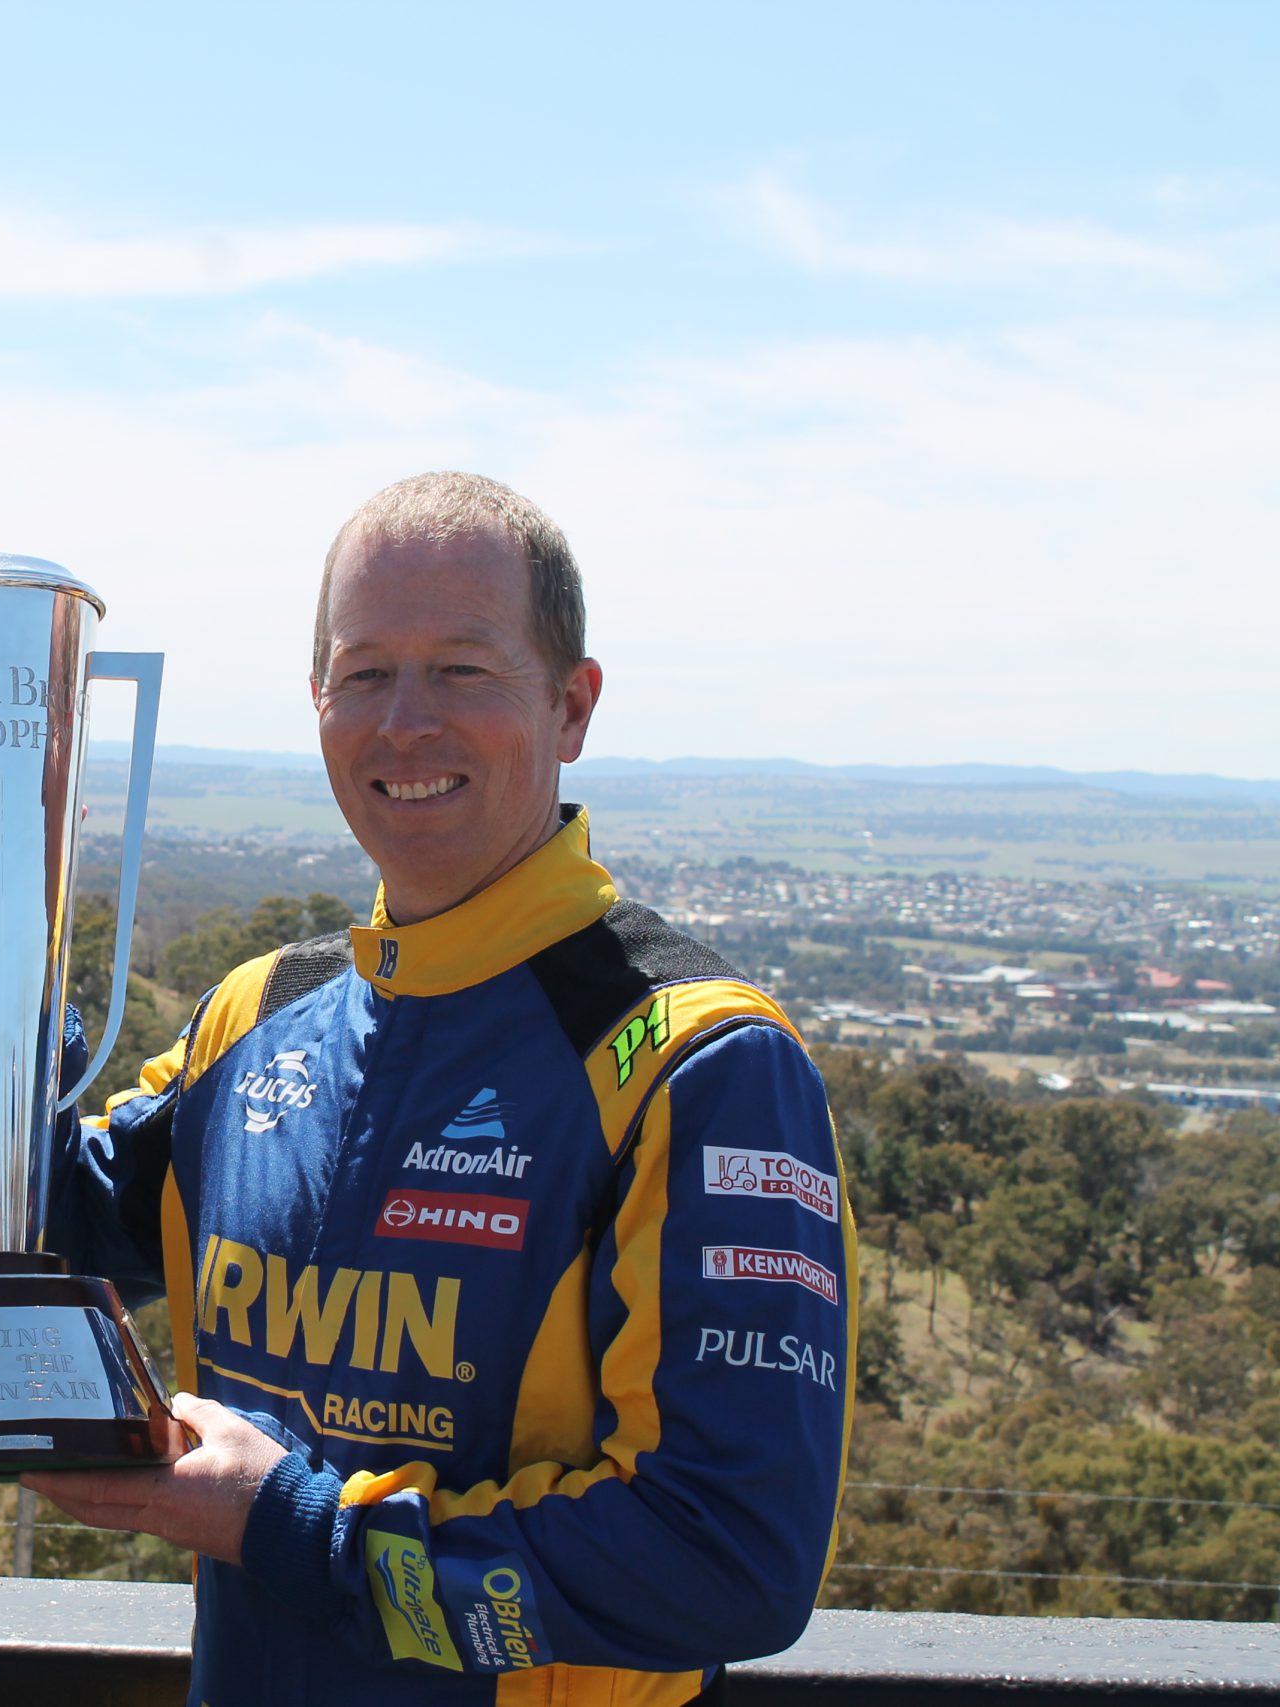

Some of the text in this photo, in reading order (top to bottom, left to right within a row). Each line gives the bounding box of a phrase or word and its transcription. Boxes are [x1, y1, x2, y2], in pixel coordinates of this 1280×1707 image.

[607, 993, 670, 1091] P1
[234, 1073, 318, 1110] FUCHS
[402, 1141, 533, 1179] ActronAir
[759, 1156, 833, 1201] TOYOTA
[417, 1206, 520, 1236] HINO
[738, 1252, 834, 1298] KENWORTH
[17, 1353, 78, 1375] THE
[695, 1326, 837, 1392] PULSAR
[322, 1393, 455, 1439] RACING
[464, 1611, 490, 1665] Plumbing
[474, 1602, 502, 1657] Electrical
